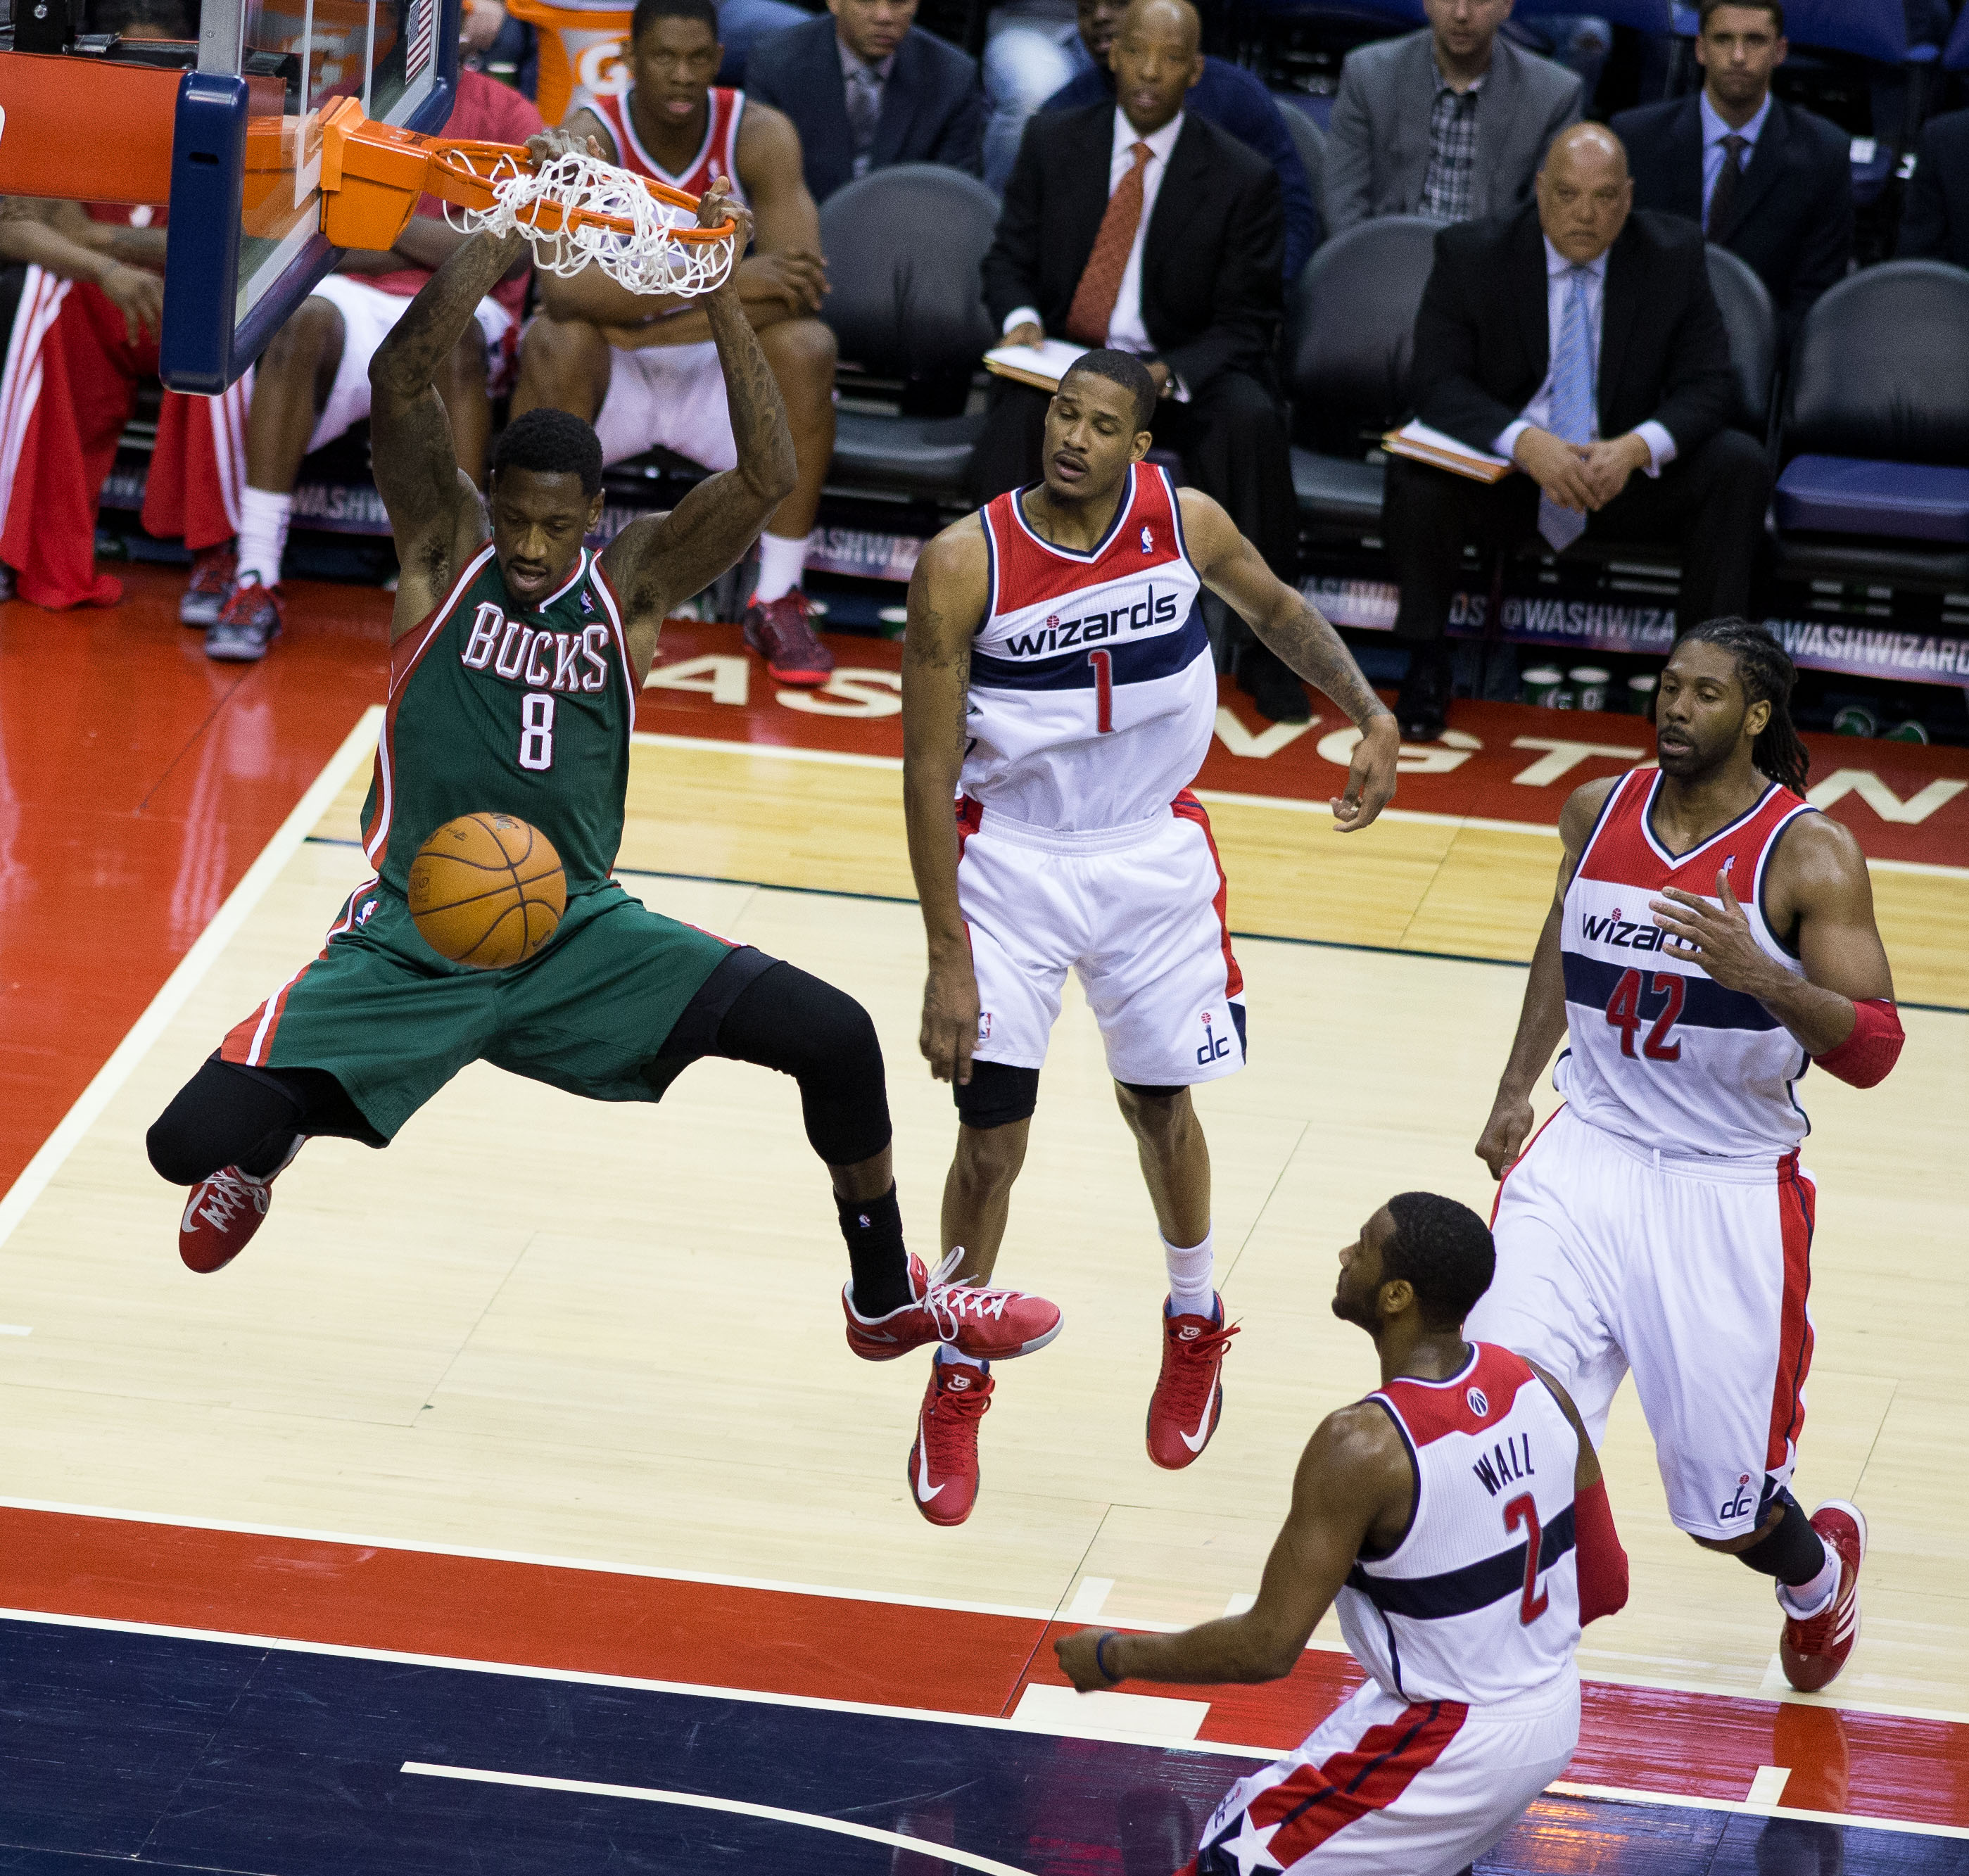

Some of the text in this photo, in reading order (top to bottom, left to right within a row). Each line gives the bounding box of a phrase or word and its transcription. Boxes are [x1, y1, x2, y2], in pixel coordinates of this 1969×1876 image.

[580, 42, 628, 96] G
[460, 600, 609, 694] BUCKS
[1006, 582, 1179, 657] wizards
[1088, 648, 1115, 734] 1
[519, 691, 556, 771] 8
[1583, 907, 1700, 953] wizar
[1197, 1023, 1229, 1065] dc
[1606, 966, 1687, 1063] 42
[1472, 1433, 1535, 1497] WALL
[1720, 1484, 1752, 1519] dc
[1502, 1491, 1549, 1628] 2
